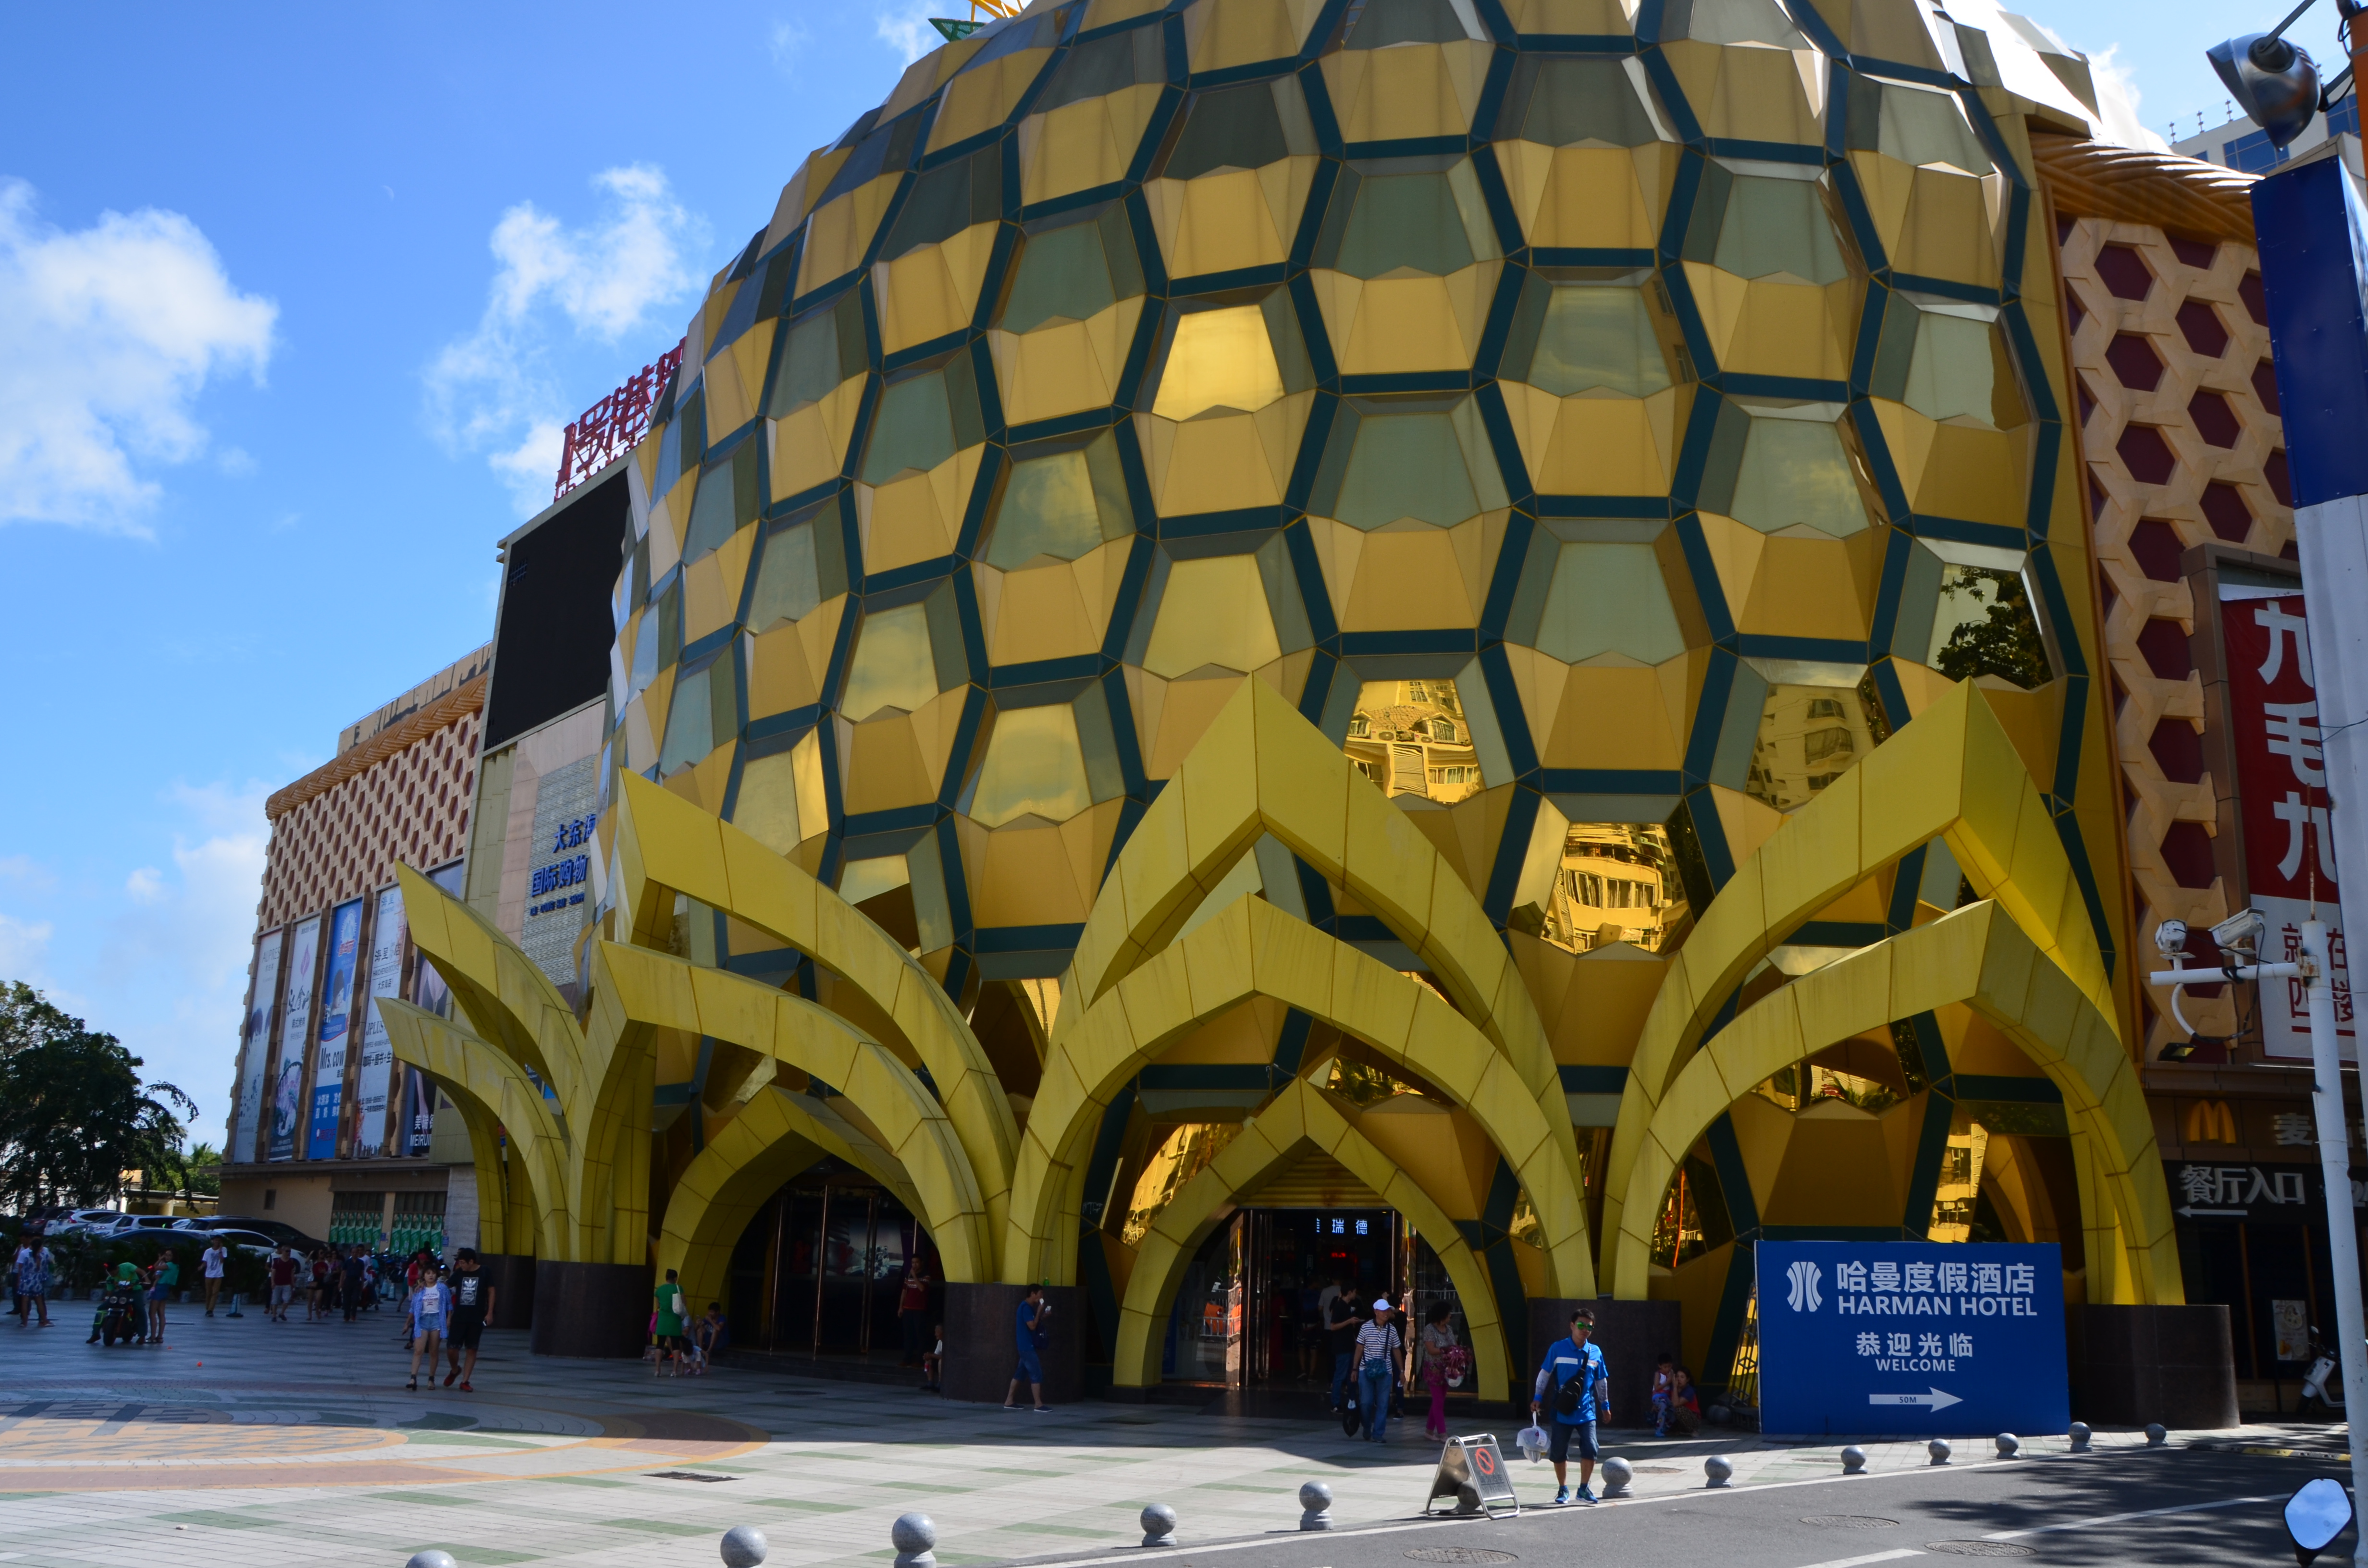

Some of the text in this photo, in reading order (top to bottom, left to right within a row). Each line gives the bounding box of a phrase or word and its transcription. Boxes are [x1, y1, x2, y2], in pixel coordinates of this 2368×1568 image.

[2255, 600, 2337, 883] 九毛九
[552, 814, 596, 853] 大东海
[531, 855, 588, 897] 国际购物
[410, 1134, 432, 1146] MEIRUI
[2179, 1164, 2306, 1205] 餐厅入口
[1316, 1218, 1368, 1234] 瑞德
[1837, 1261, 2035, 1294] 哈曼度假酒店
[1838, 1296, 2038, 1316] HARMAN HOTEL
[1856, 1332, 1973, 1358] 恭迎光临
[1875, 1359, 1956, 1372] WELCOME
[1899, 1396, 1917, 1404] 50M
